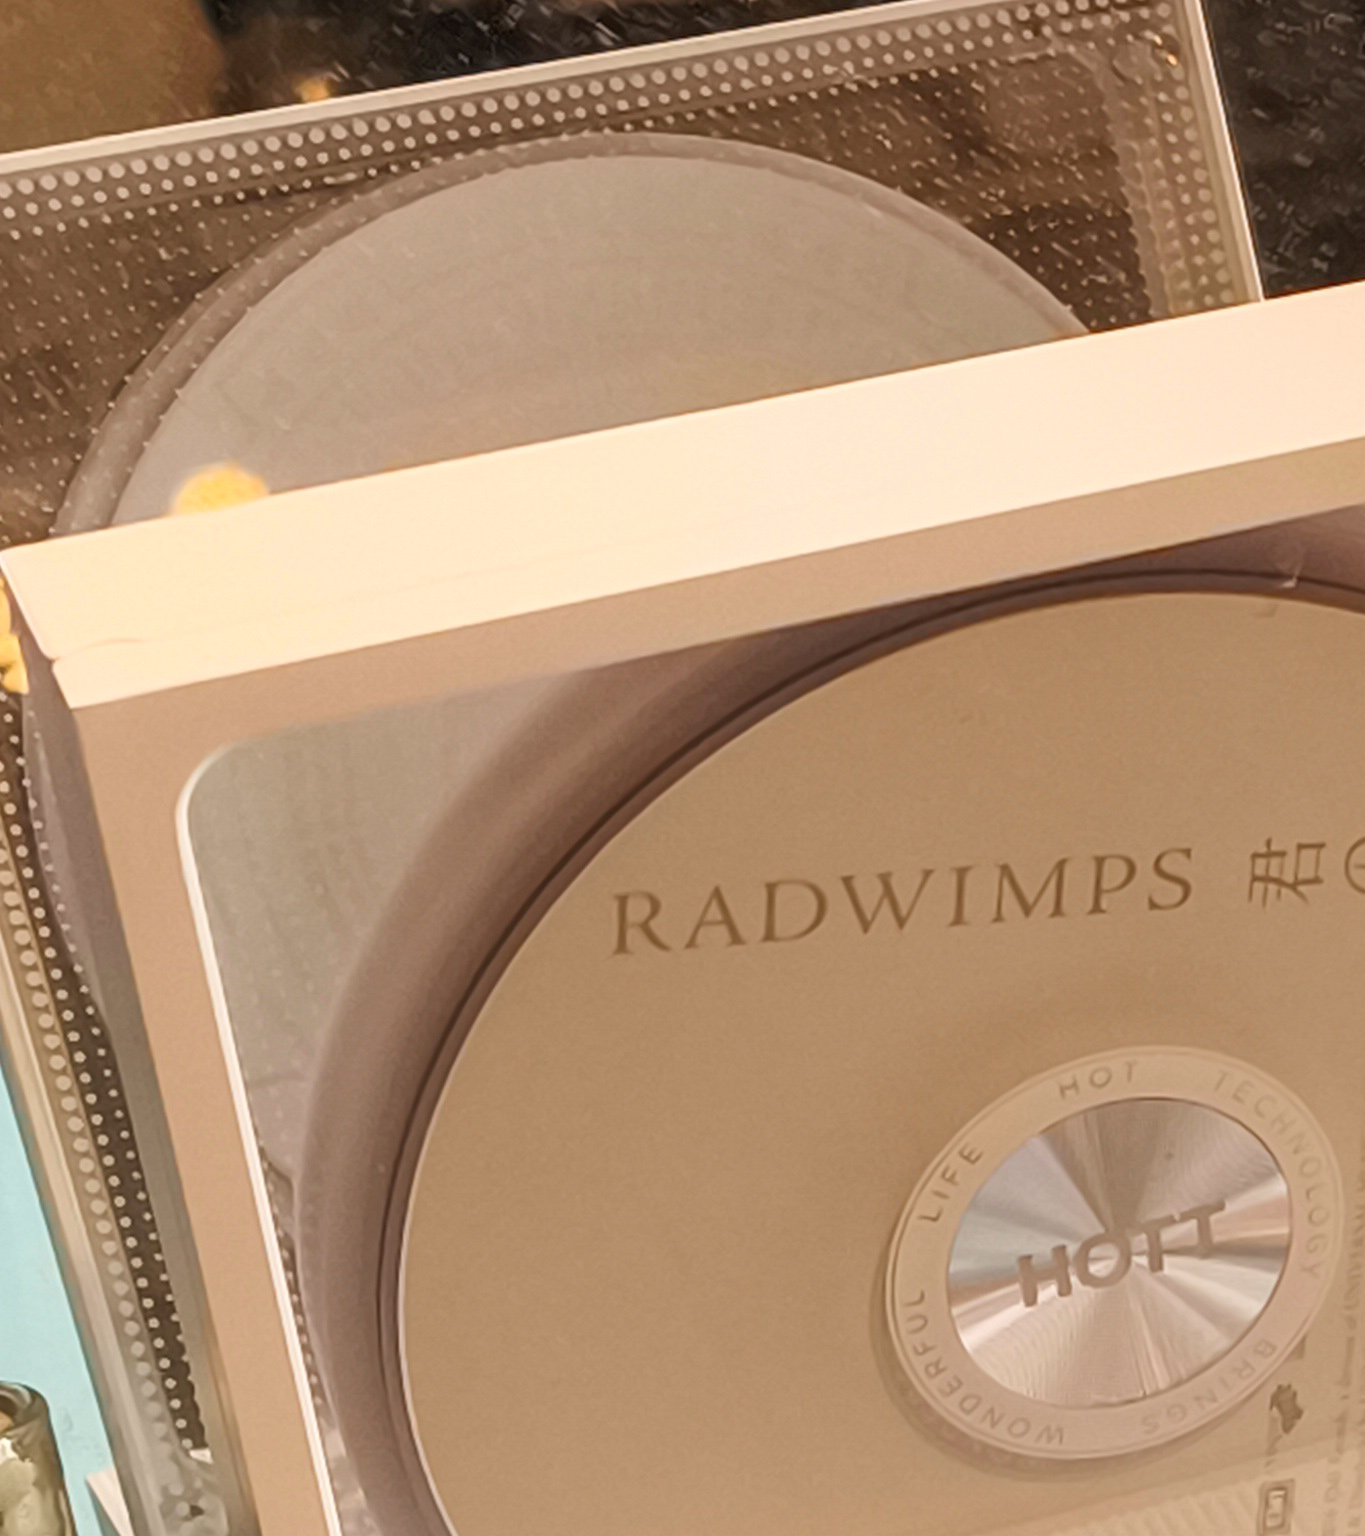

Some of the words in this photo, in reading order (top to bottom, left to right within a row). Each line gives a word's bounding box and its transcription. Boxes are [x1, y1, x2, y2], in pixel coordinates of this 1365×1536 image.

[610, 846, 1193, 956] RADWIMPS
[1057, 1060, 1139, 1100] HOT
[917, 1140, 983, 1225] LIFE
[1211, 1068, 1332, 1280] TECHNOLOGY
[1016, 1199, 1227, 1308] HOTT
[902, 1289, 1067, 1446] WONDERFUL
[1140, 1338, 1278, 1436] BRINGS
